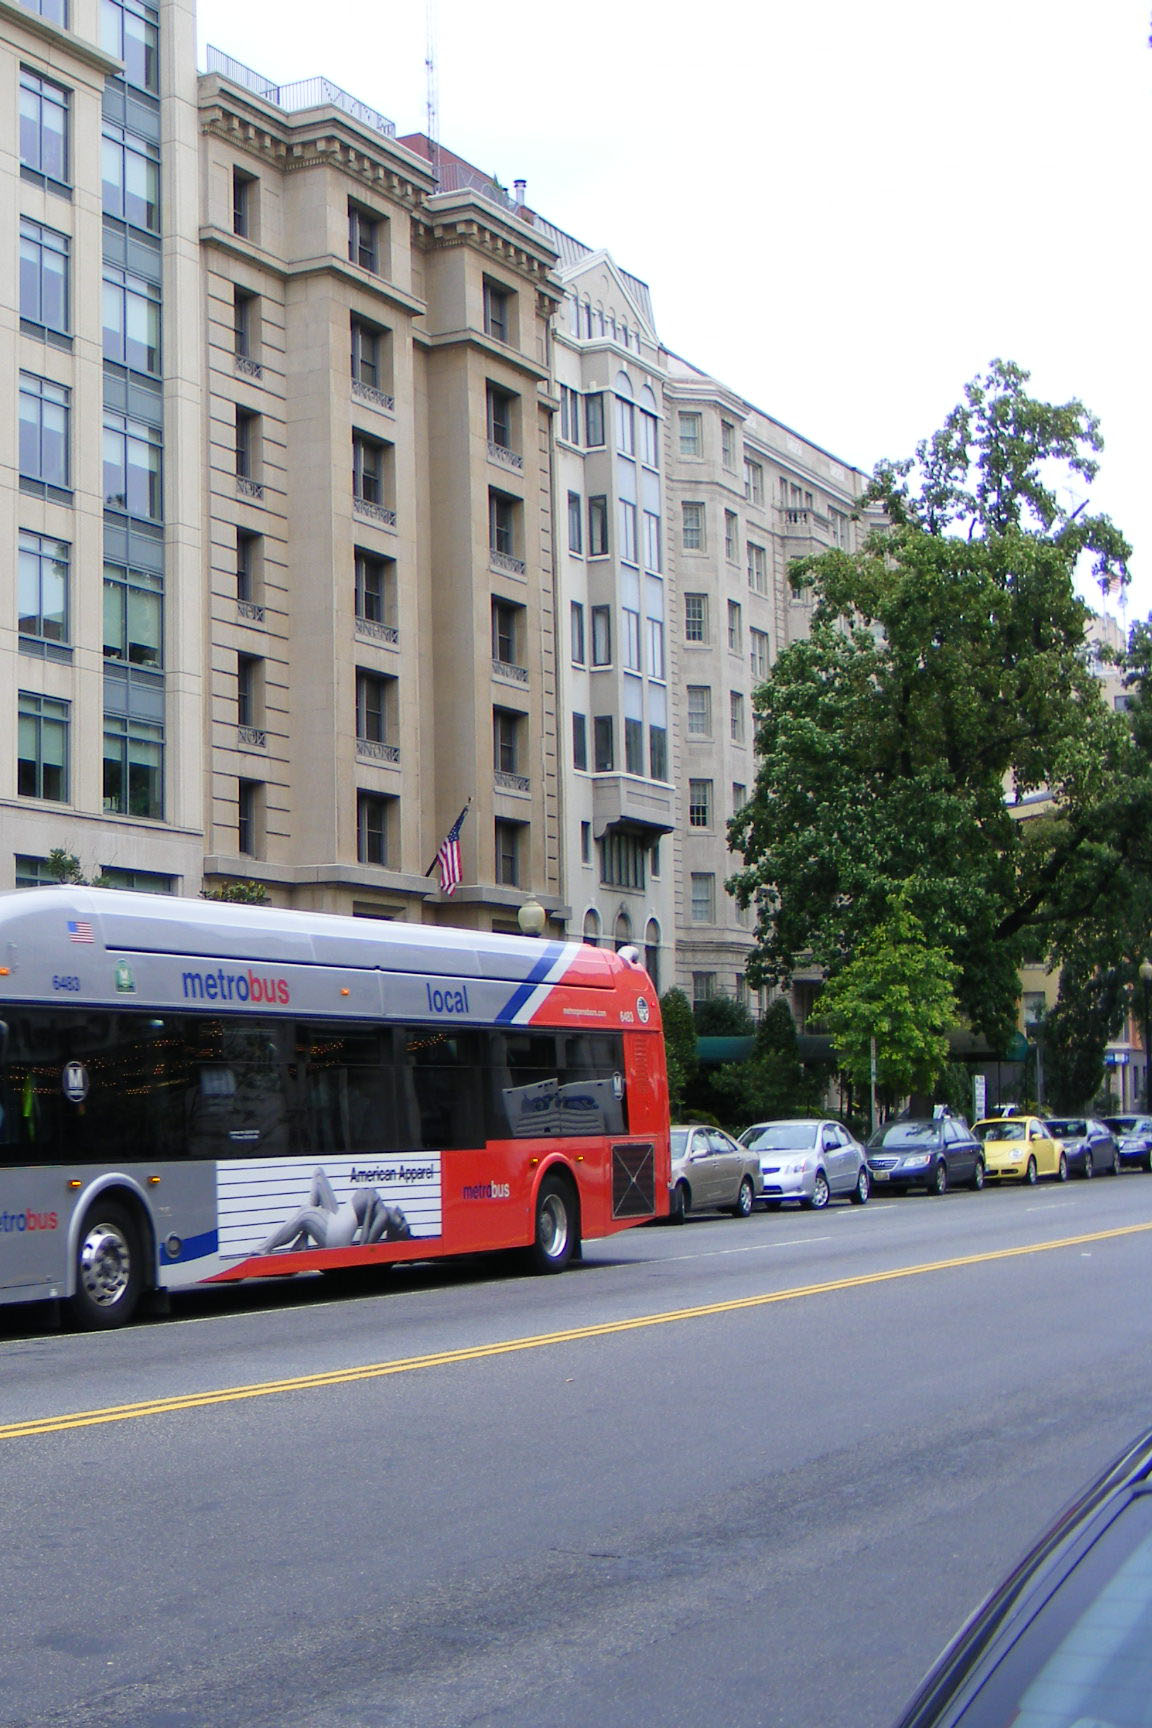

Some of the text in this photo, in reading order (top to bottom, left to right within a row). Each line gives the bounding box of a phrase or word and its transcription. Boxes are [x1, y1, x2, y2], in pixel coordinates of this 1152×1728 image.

[52, 975, 82, 992] 6483
[182, 968, 291, 1004] metrobus
[426, 983, 470, 1014] local
[350, 1163, 434, 1184] American Apparel
[463, 1180, 511, 1200] metrobus
